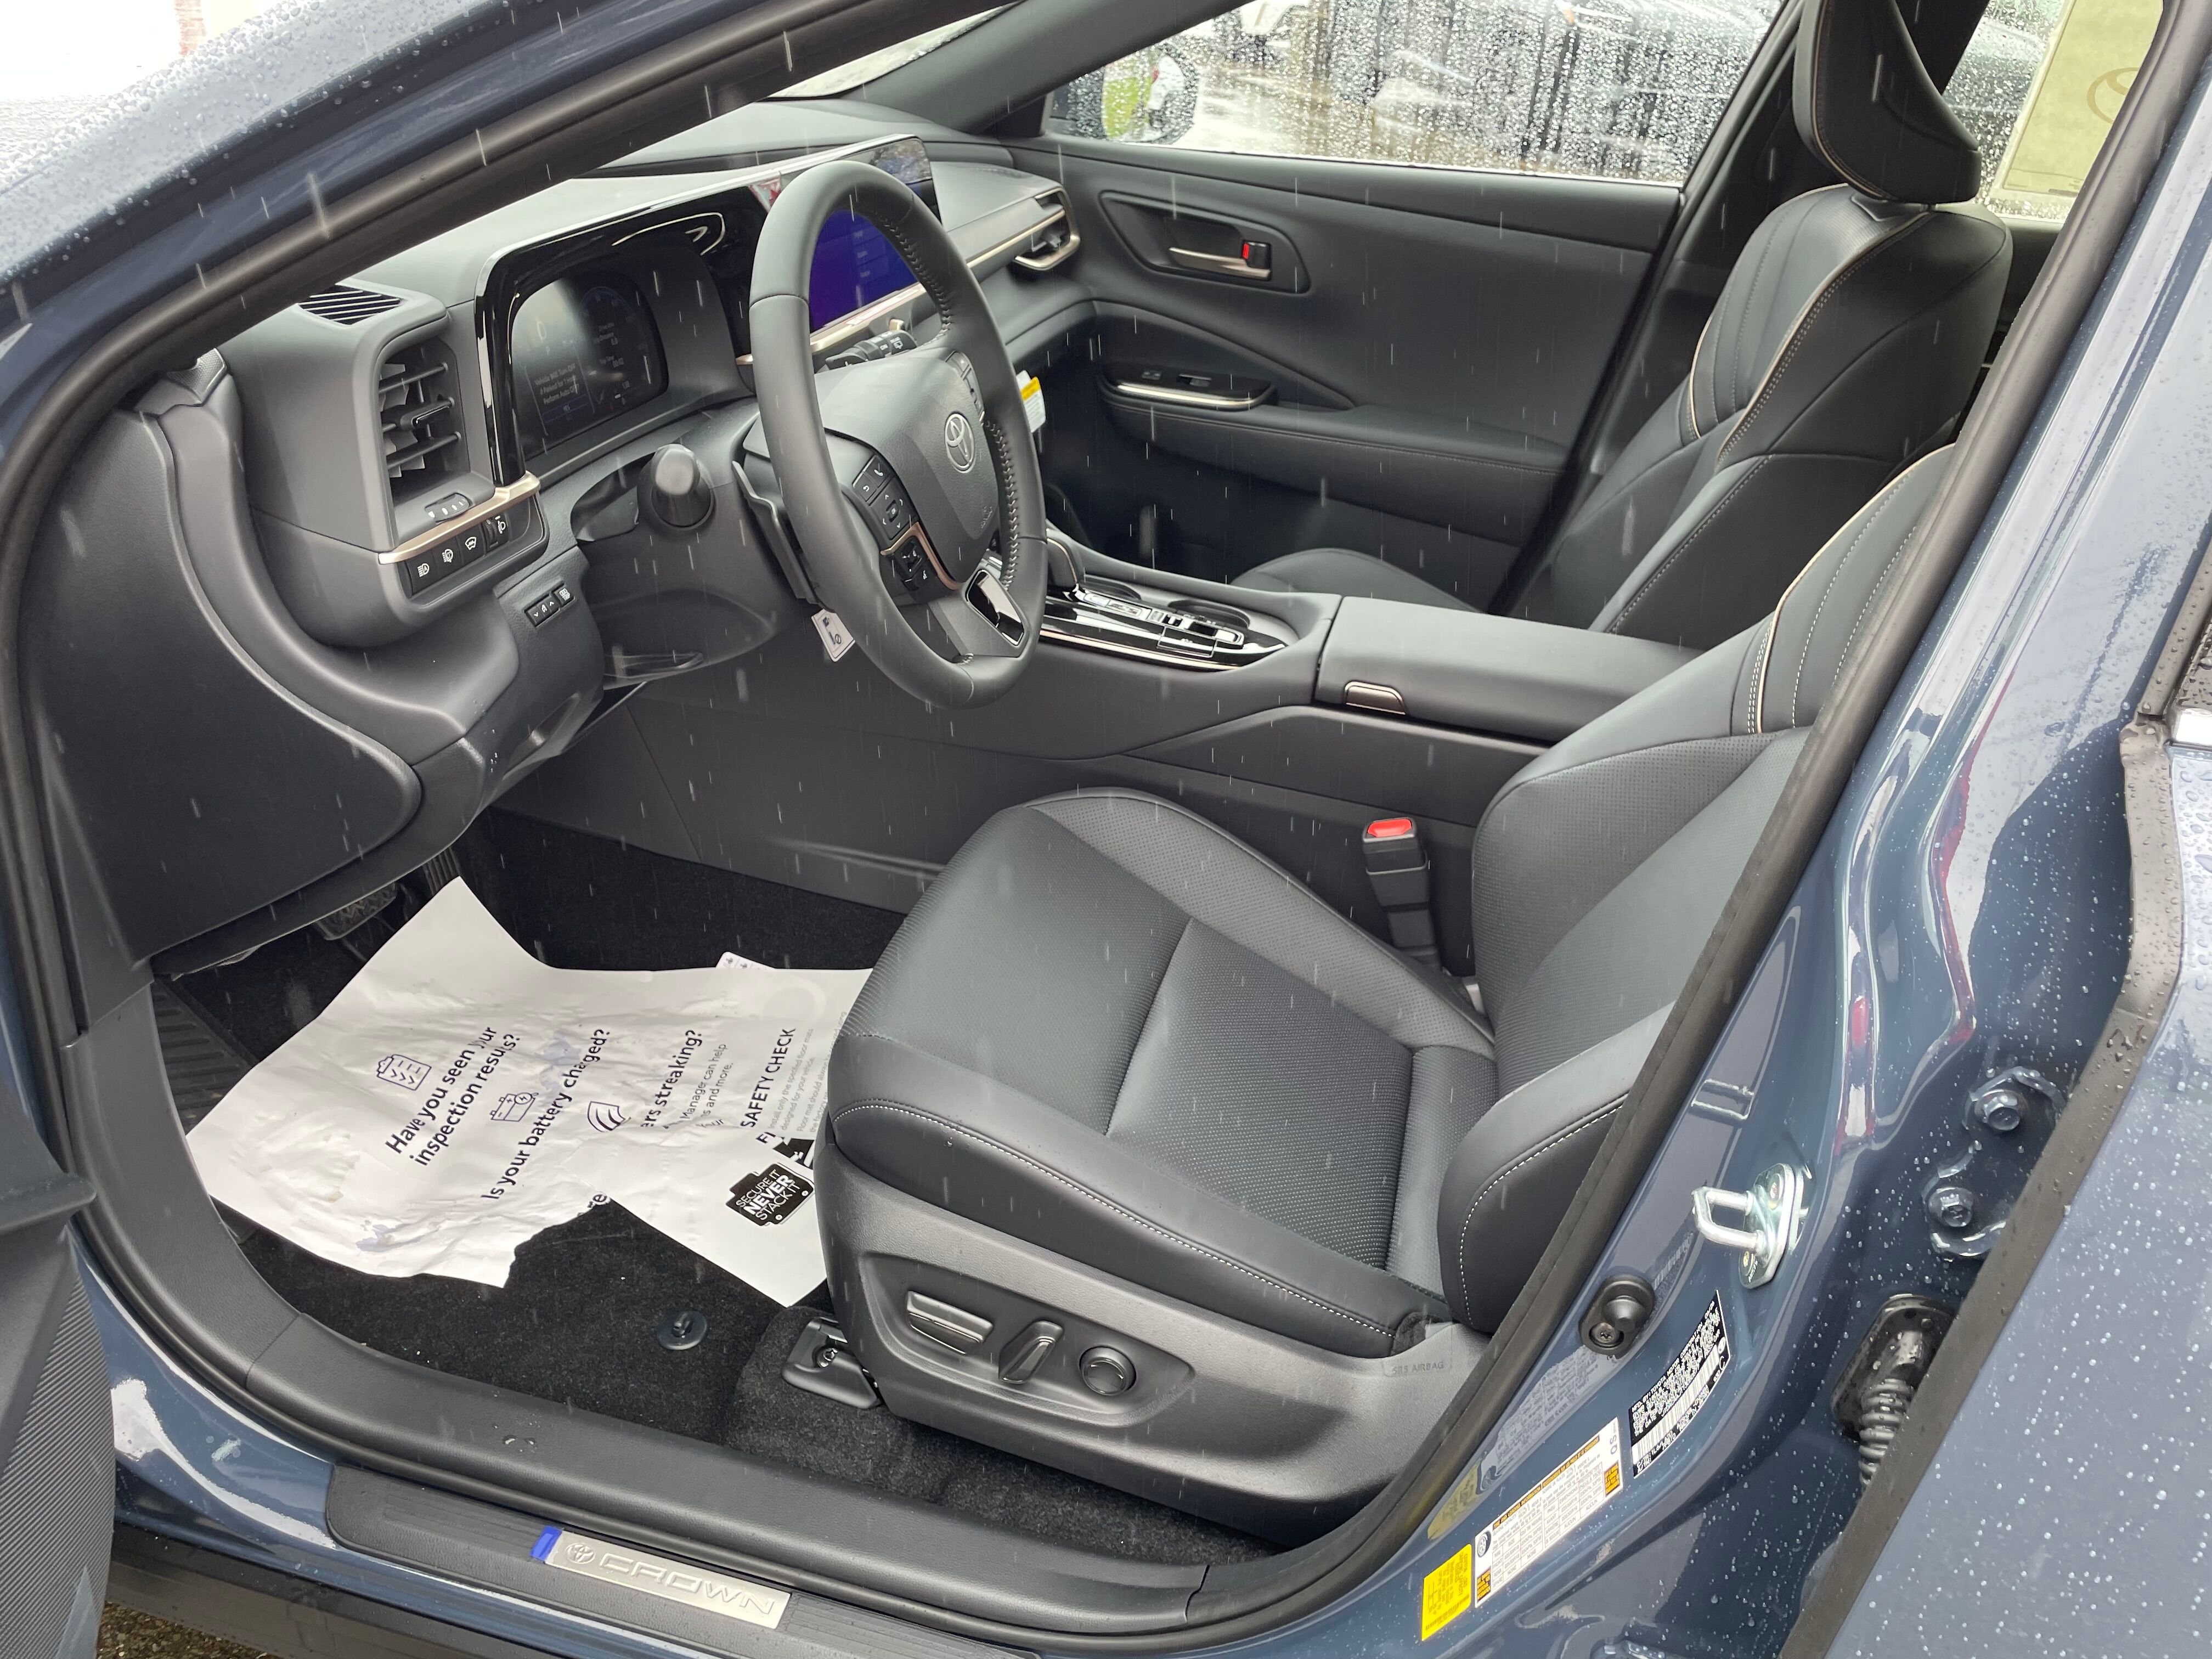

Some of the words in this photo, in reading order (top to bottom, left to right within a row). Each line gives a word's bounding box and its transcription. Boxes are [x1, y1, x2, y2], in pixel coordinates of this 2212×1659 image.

[654, 1030, 702, 1107] streaking?
[704, 1064, 716, 1081] can
[708, 1043, 728, 1062] help
[707, 1089, 719, 1108] and
[715, 1063, 733, 1087] more.
[741, 1076, 774, 1127] SAFETY
[765, 1028, 796, 1073] CHECK
[777, 1092, 789, 1110] only
[783, 1082, 791, 1096] the
[797, 1074, 807, 1092] your
[385, 1118, 425, 1154] Have
[417, 1087, 448, 1121] you
[443, 1049, 476, 1085] seen
[793, 1092, 803, 1104] for
[409, 1082, 482, 1166] inspection
[481, 1187, 505, 1199] Is
[497, 1150, 530, 1186] your
[518, 1092, 572, 1147] battery
[736, 1177, 773, 1207] SECURE
[769, 1169, 780, 1180] IT
[743, 1175, 793, 1215] NEVER
[755, 1190, 793, 1221] STACK
[787, 1181, 800, 1193] IT
[1411, 1360, 1444, 1373] AIRBAG
[600, 1553, 776, 1615] CROWN
